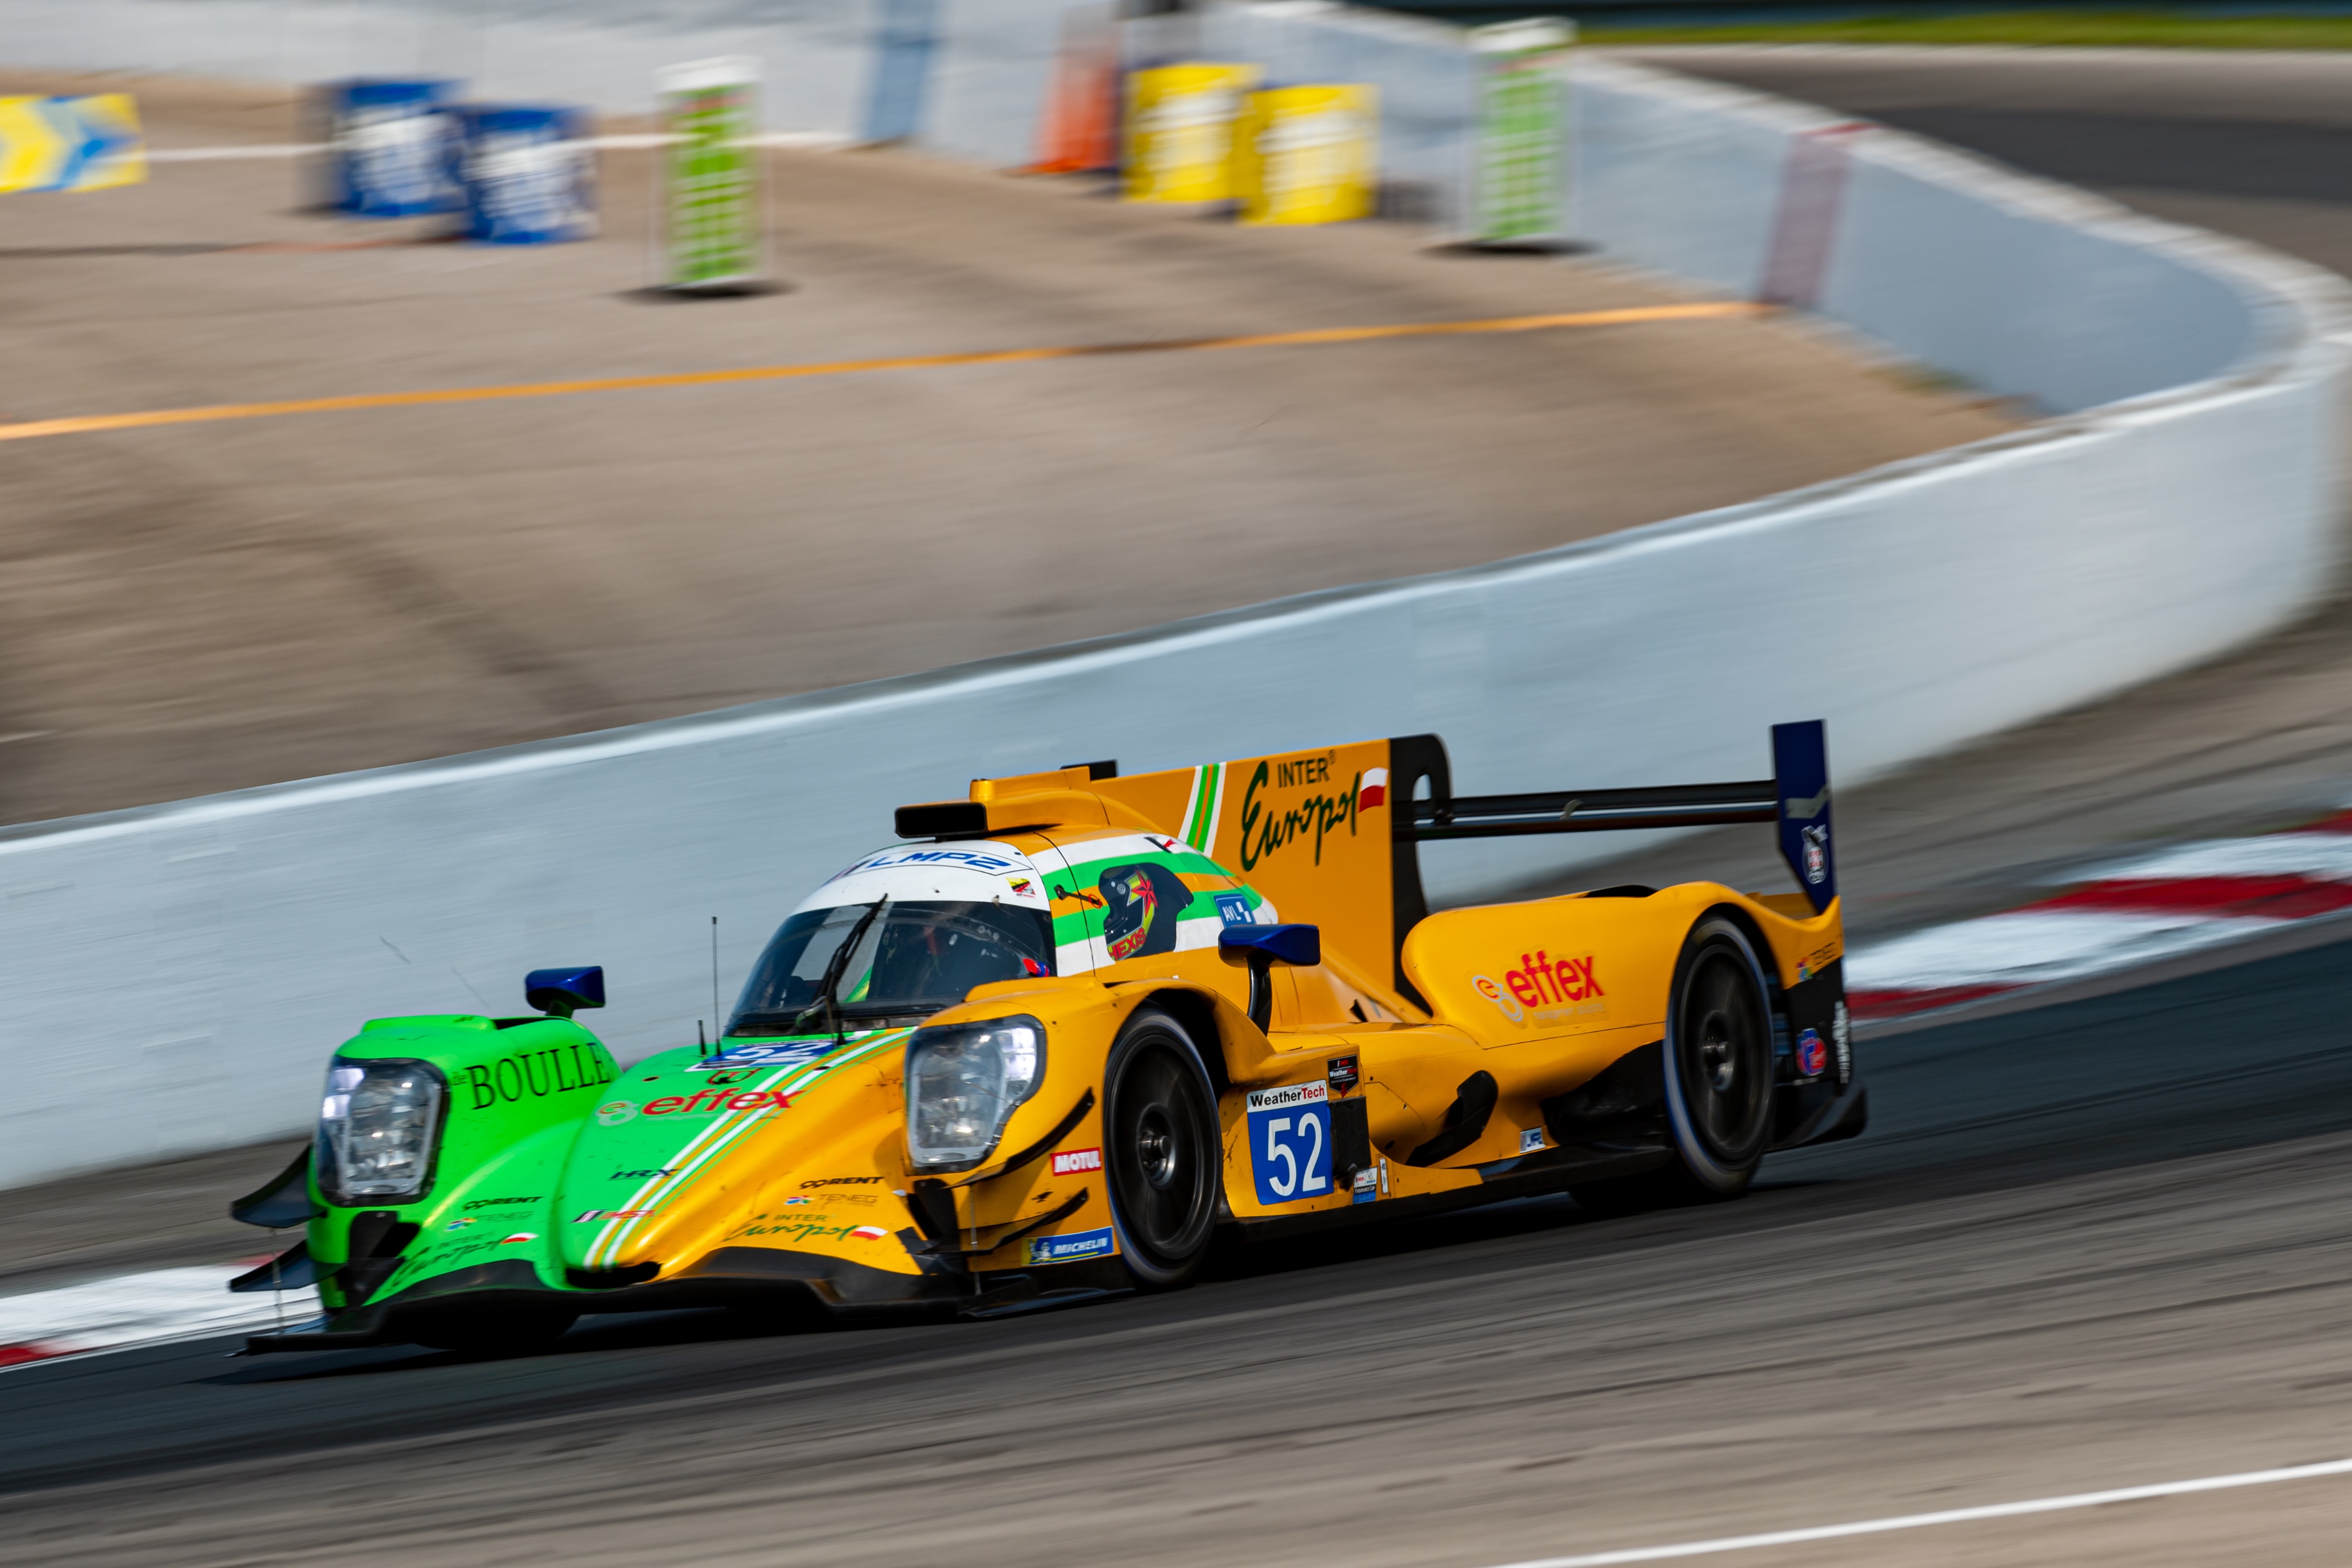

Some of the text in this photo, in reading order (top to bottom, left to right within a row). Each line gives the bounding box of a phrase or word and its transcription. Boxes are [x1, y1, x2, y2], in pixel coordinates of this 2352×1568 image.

[1277, 757, 1330, 789] INTER
[1240, 760, 1361, 873] Europol
[865, 851, 1012, 870] LMP2
[1222, 905, 1241, 922] AVL
[1109, 928, 1146, 960] HEXIS
[1505, 950, 1606, 1008] effex
[724, 1042, 834, 1060] 52
[463, 1042, 611, 1111] BOULLE
[641, 1087, 806, 1116] effex
[1250, 1084, 1325, 1107] WeatherTech
[1054, 1151, 1101, 1173] MOTUL
[1268, 1112, 1326, 1197] 52
[609, 1168, 681, 1179] HRX
[818, 1194, 879, 1204] TENEG
[1052, 1237, 1108, 1255] MICHELIN
